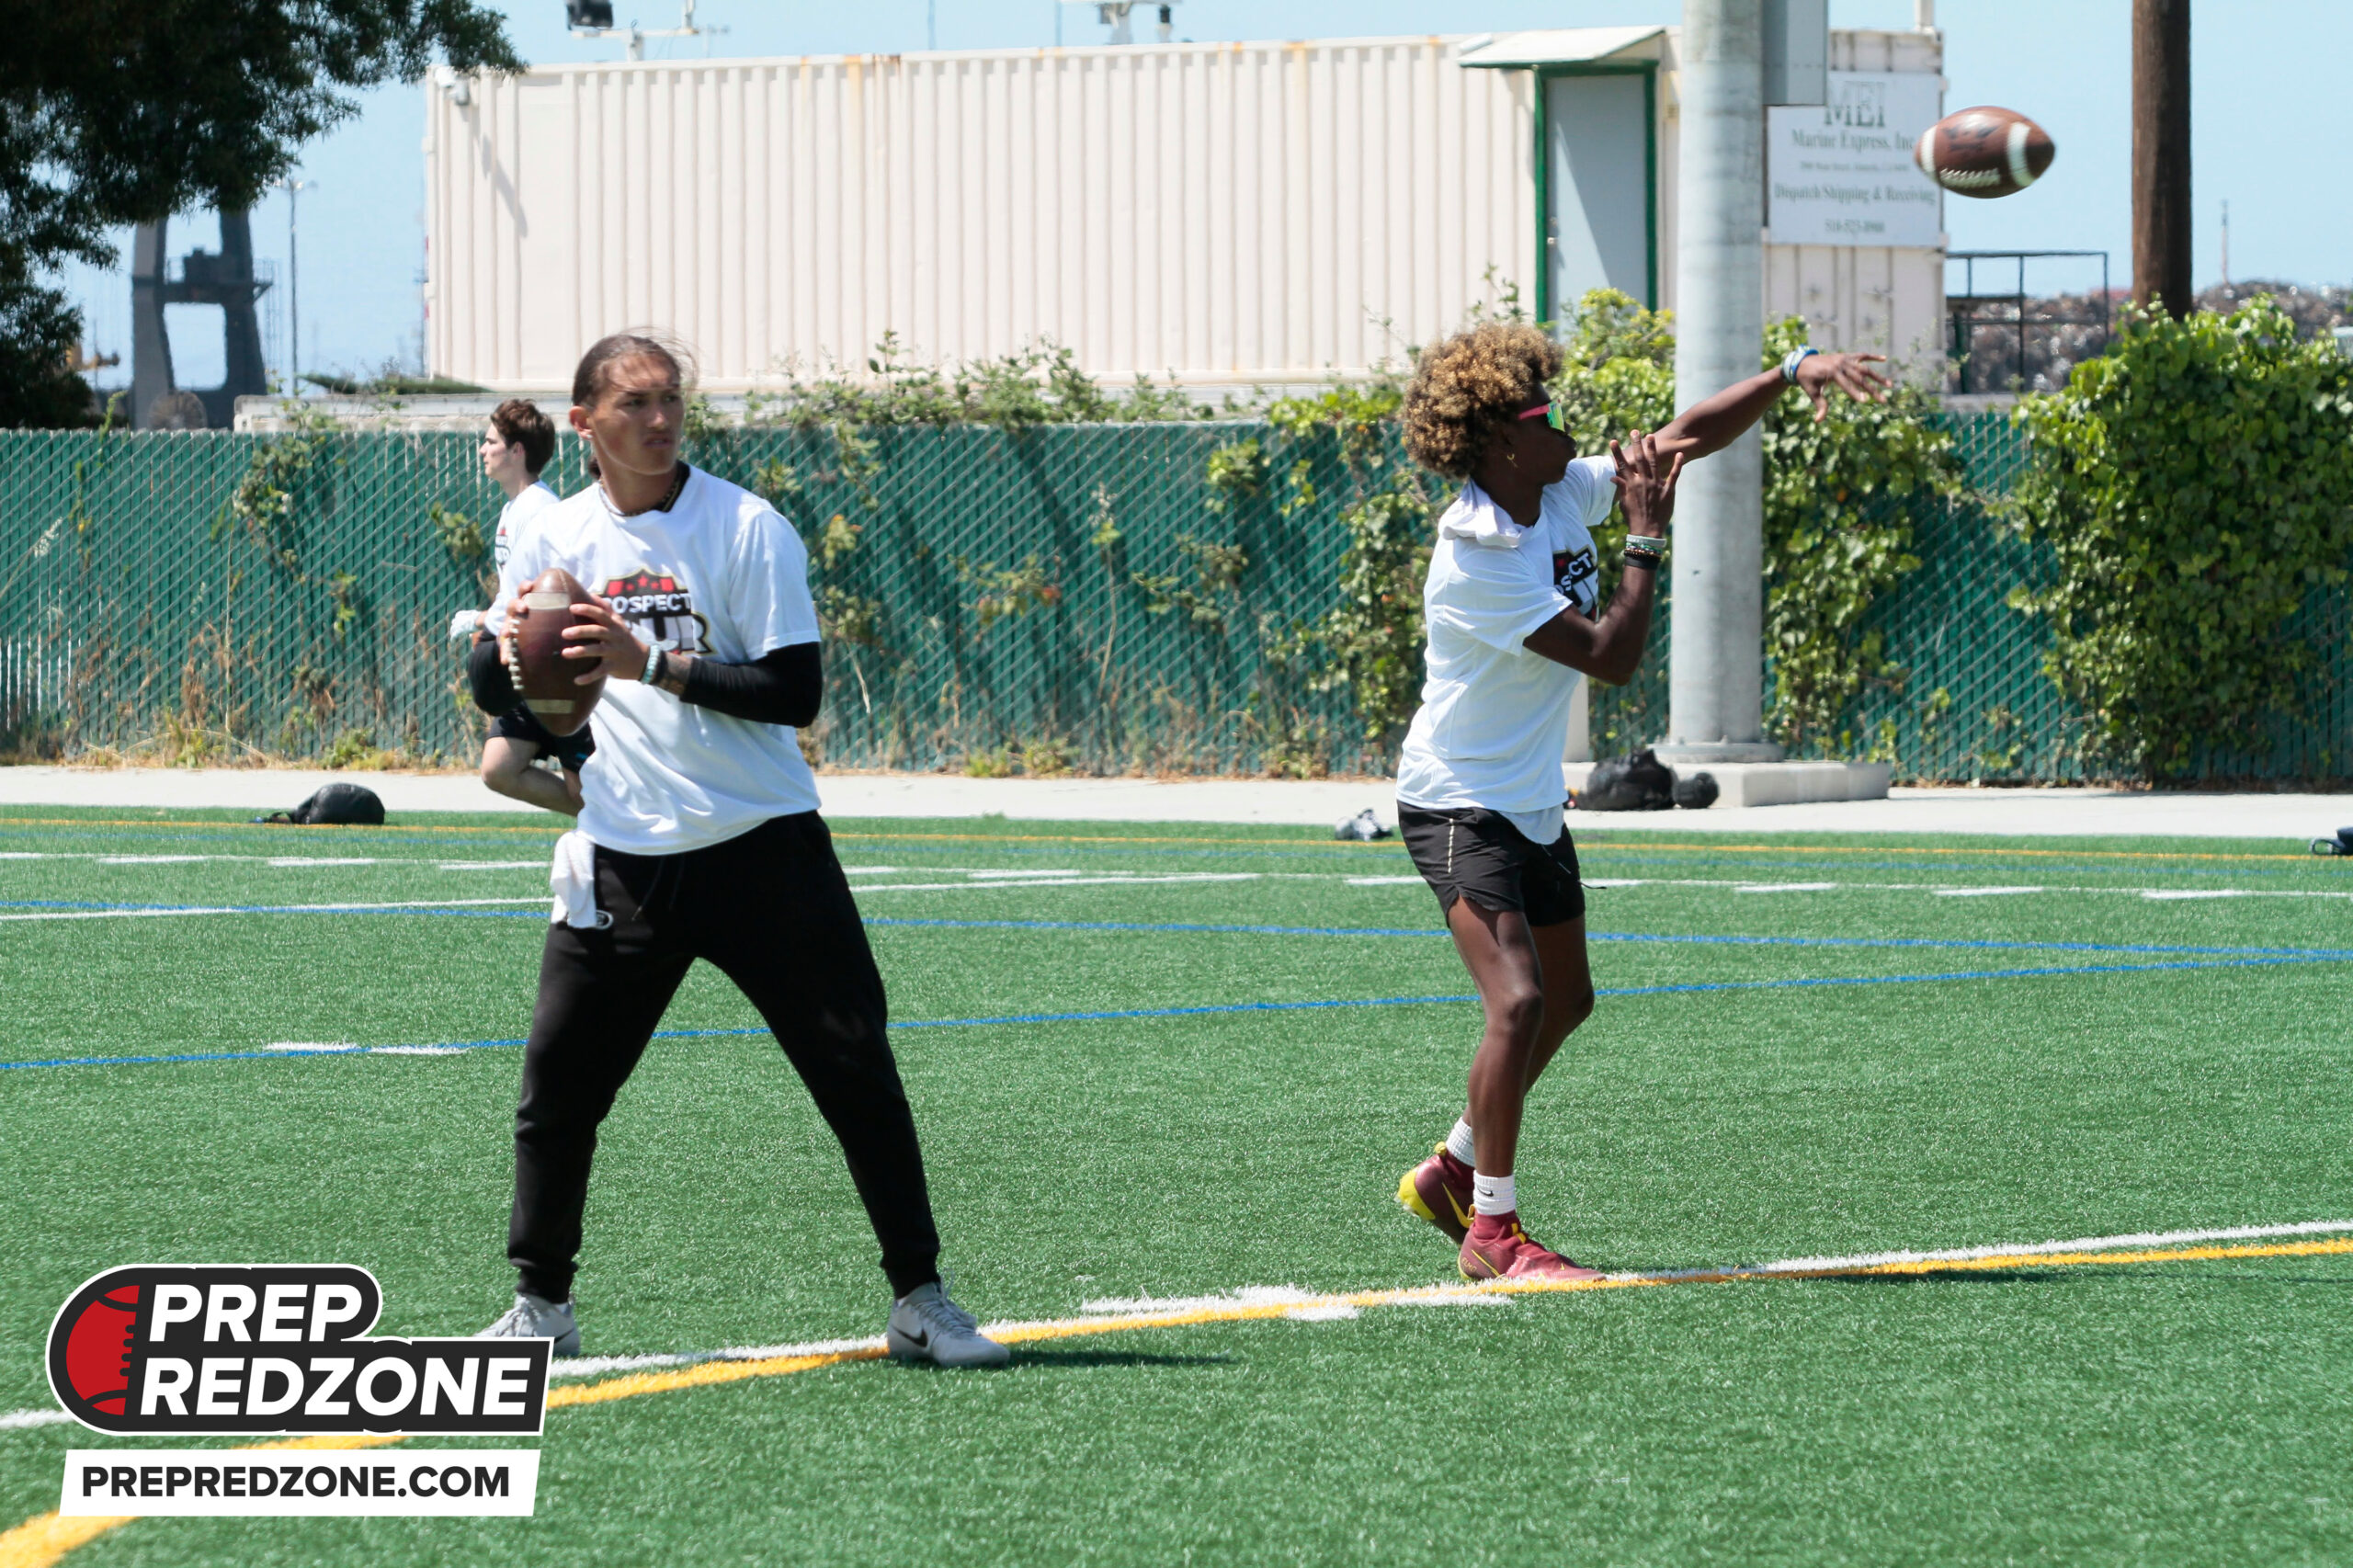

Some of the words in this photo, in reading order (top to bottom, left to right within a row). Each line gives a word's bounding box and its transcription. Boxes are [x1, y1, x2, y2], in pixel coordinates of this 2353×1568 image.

[1792, 129, 1836, 148] Marine
[1774, 183, 1820, 203] Dispatch
[1823, 185, 1870, 205] Shipping
[1872, 185, 1881, 199] &
[1885, 186, 1936, 206] Receiving
